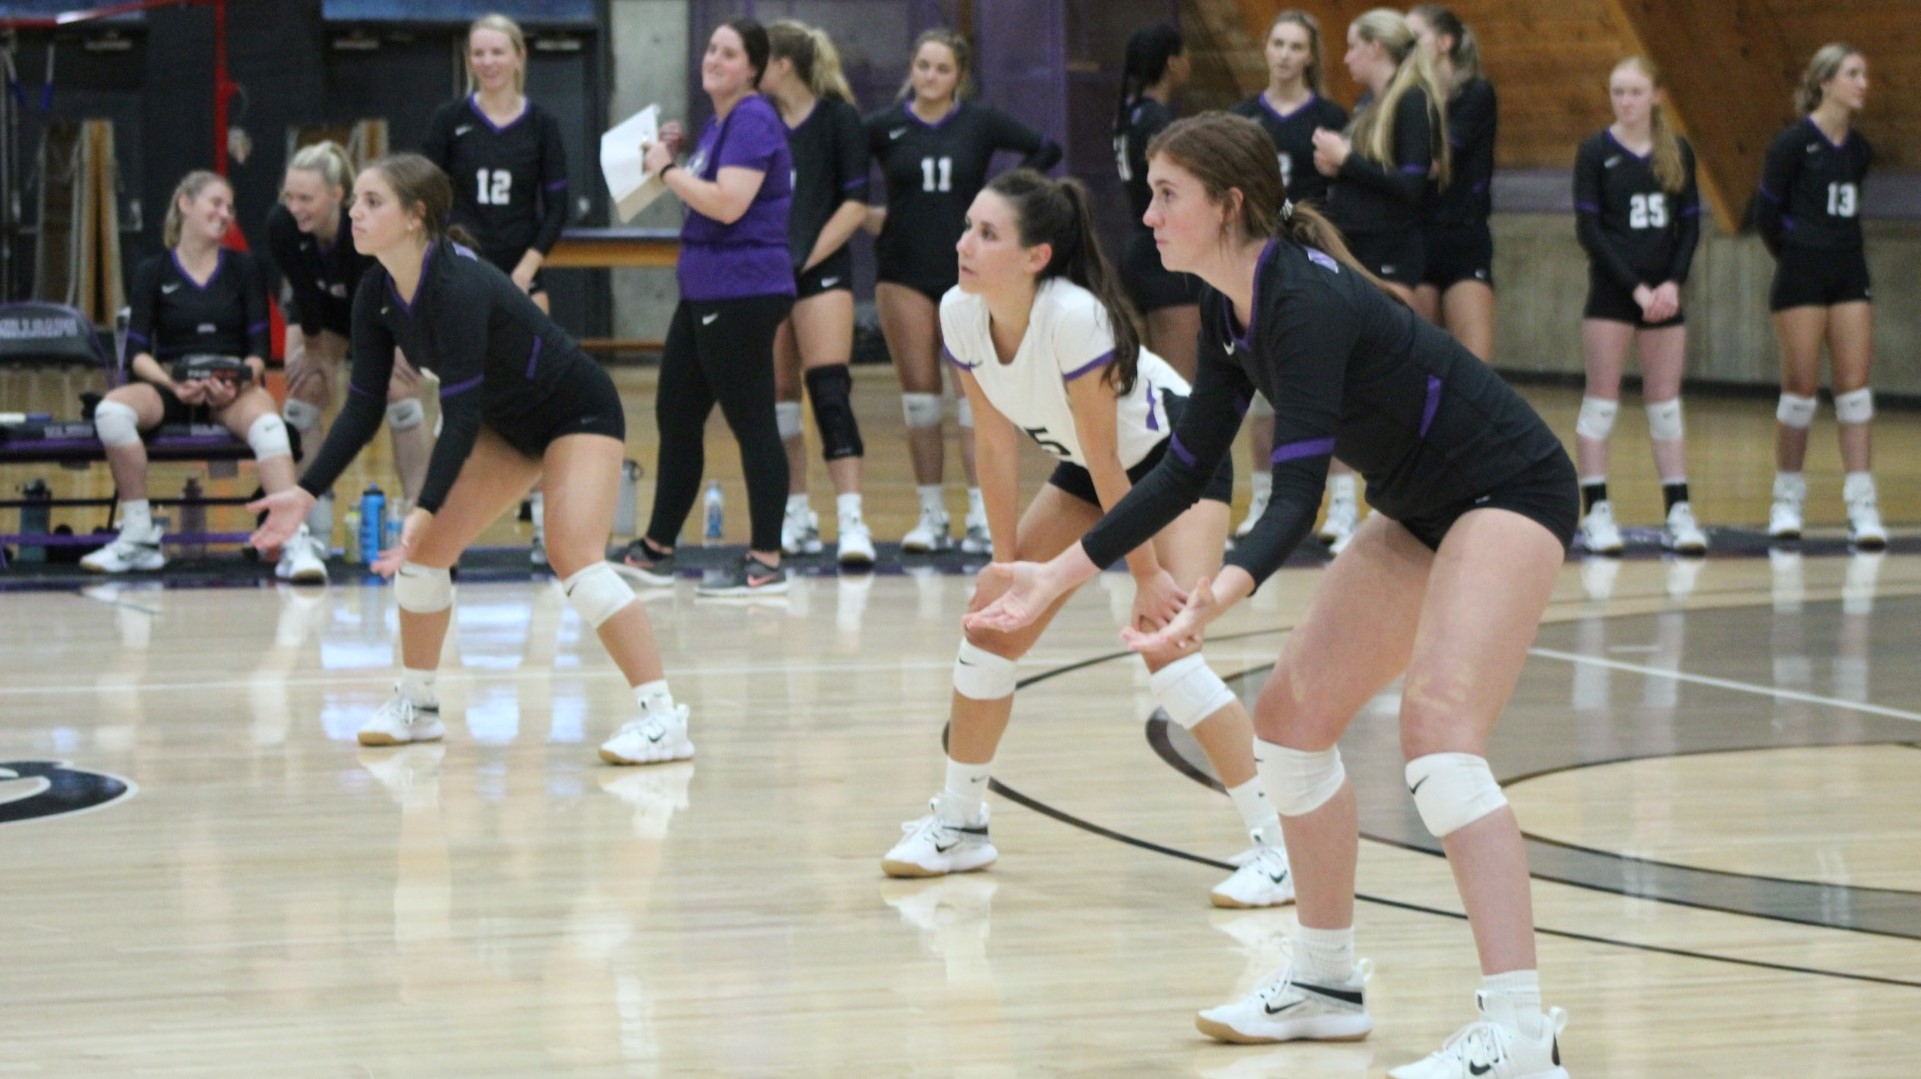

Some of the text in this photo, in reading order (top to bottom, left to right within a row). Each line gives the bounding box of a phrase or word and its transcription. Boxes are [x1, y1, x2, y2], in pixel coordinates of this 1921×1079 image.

[477, 168, 512, 205] 12
[921, 157, 953, 192] 11
[1630, 193, 1669, 228] 25
[1827, 182, 1857, 217] 13
